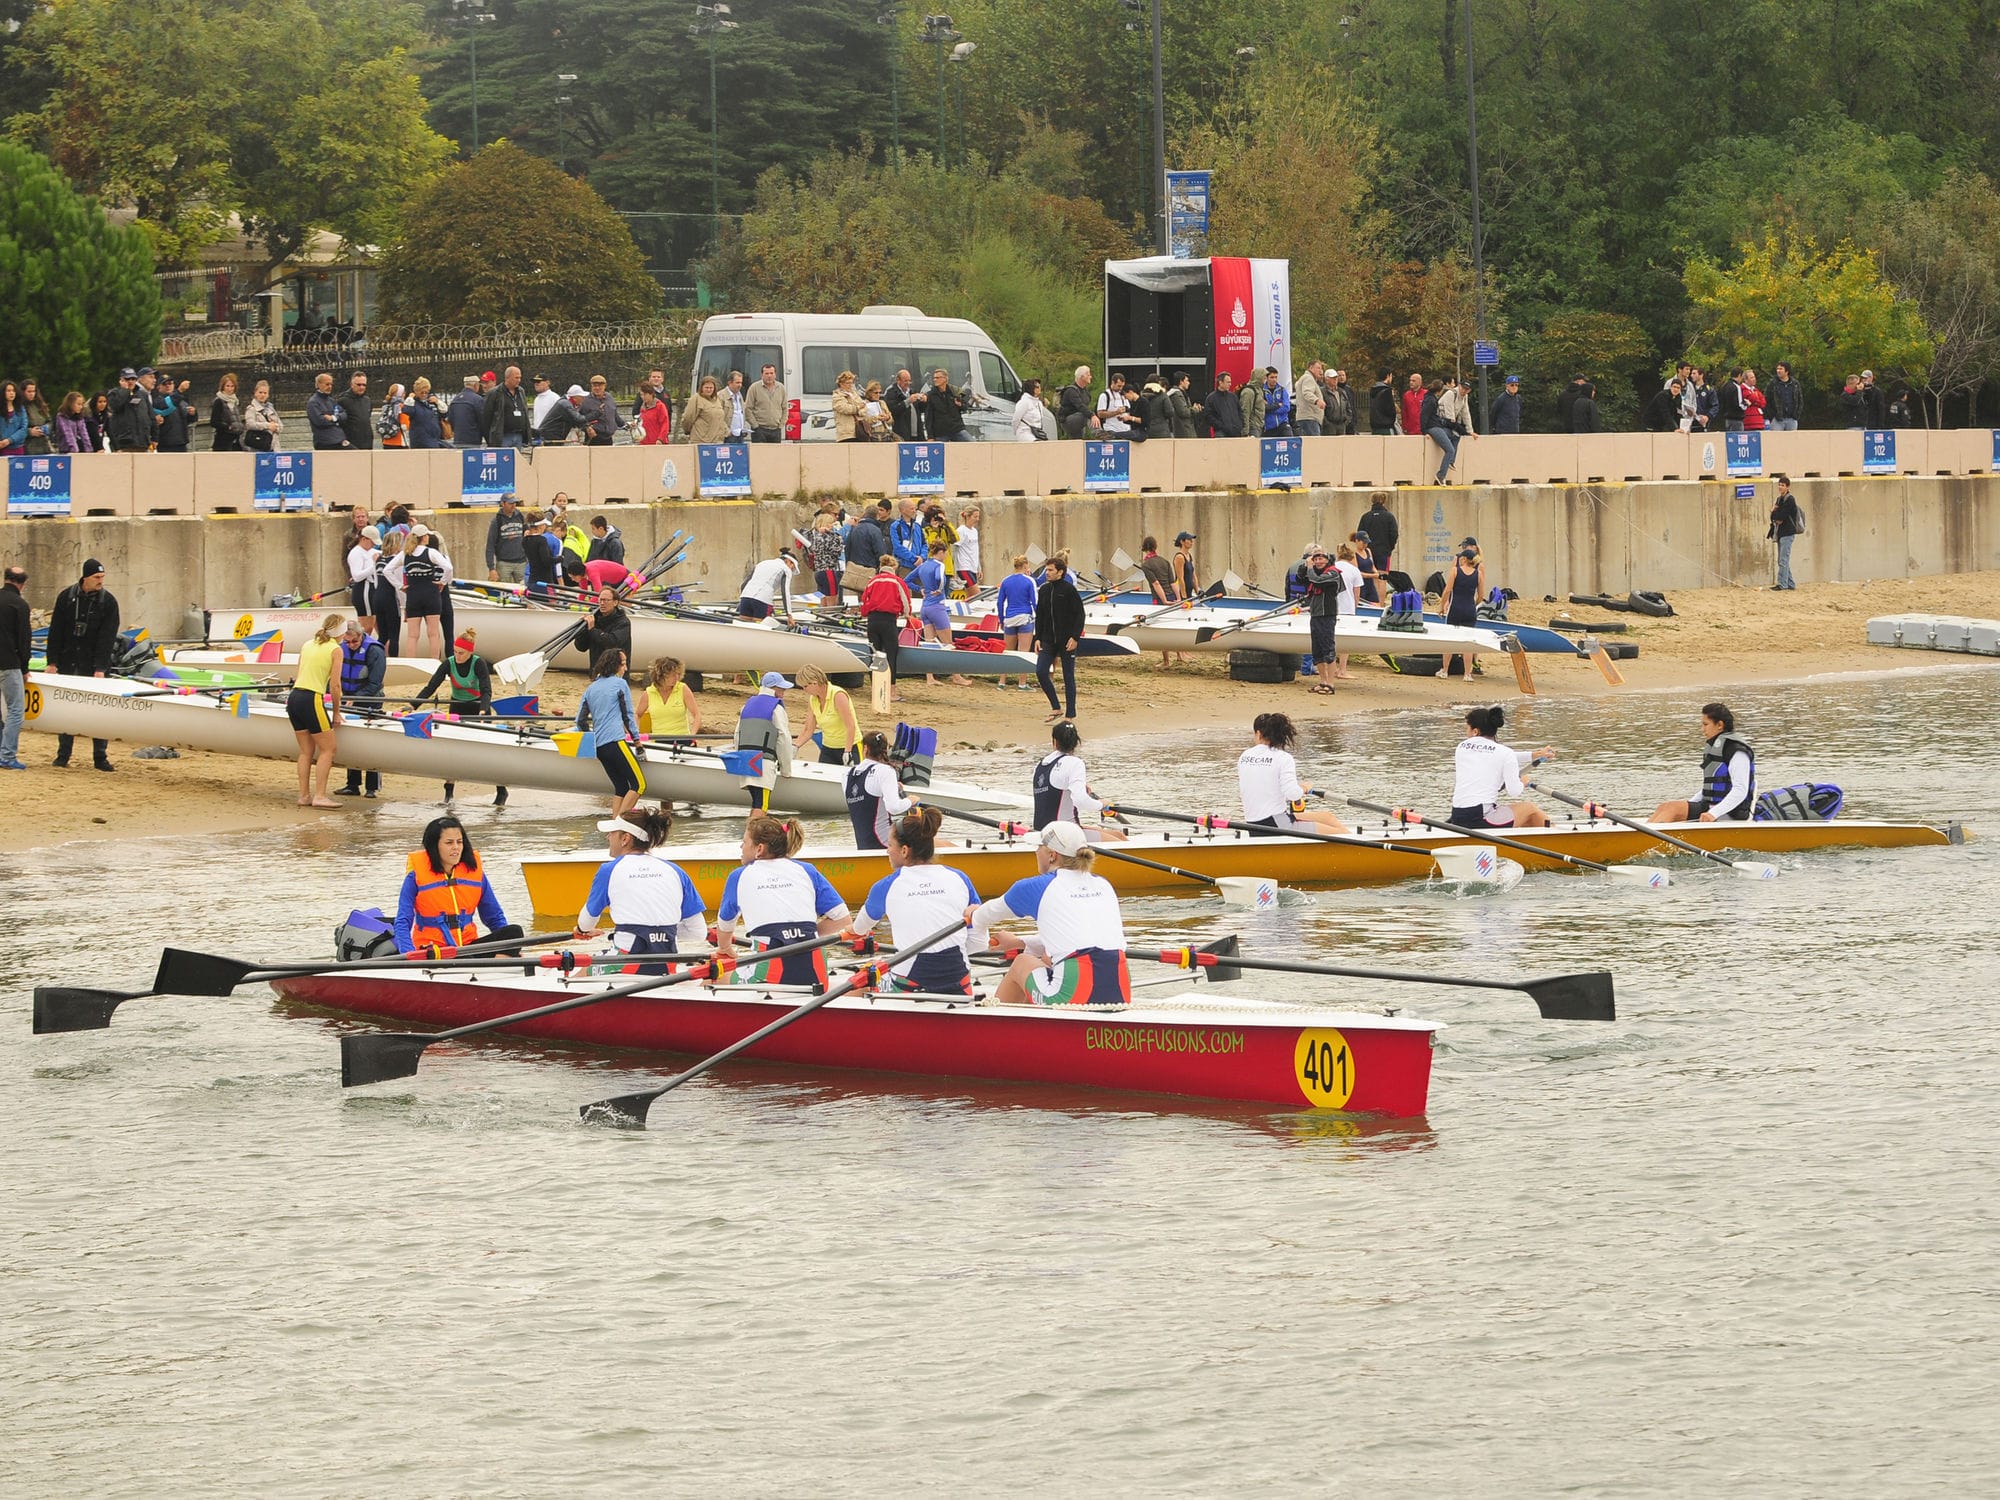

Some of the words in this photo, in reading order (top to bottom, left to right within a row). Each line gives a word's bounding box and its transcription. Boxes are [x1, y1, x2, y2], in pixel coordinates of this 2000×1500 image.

[1737, 446, 1750, 458] 101
[1874, 445, 1885, 456] 102
[913, 460, 930, 473] 413
[1099, 458, 1115, 470] 414
[1274, 454, 1289, 466] 415
[715, 461, 734, 474] 412
[273, 471, 294, 486] 410
[480, 468, 497, 481] 411
[28, 475, 52, 490] 409
[234, 620, 252, 637] 409
[24, 690, 40, 714] 08
[53, 689, 153, 712] EURODIFFUSIONS.COM
[649, 933, 669, 943] BUL
[782, 928, 805, 940] BUL
[1086, 1027, 1244, 1053] EURODIFFUSIONS.COM
[1304, 1040, 1346, 1096] 401
